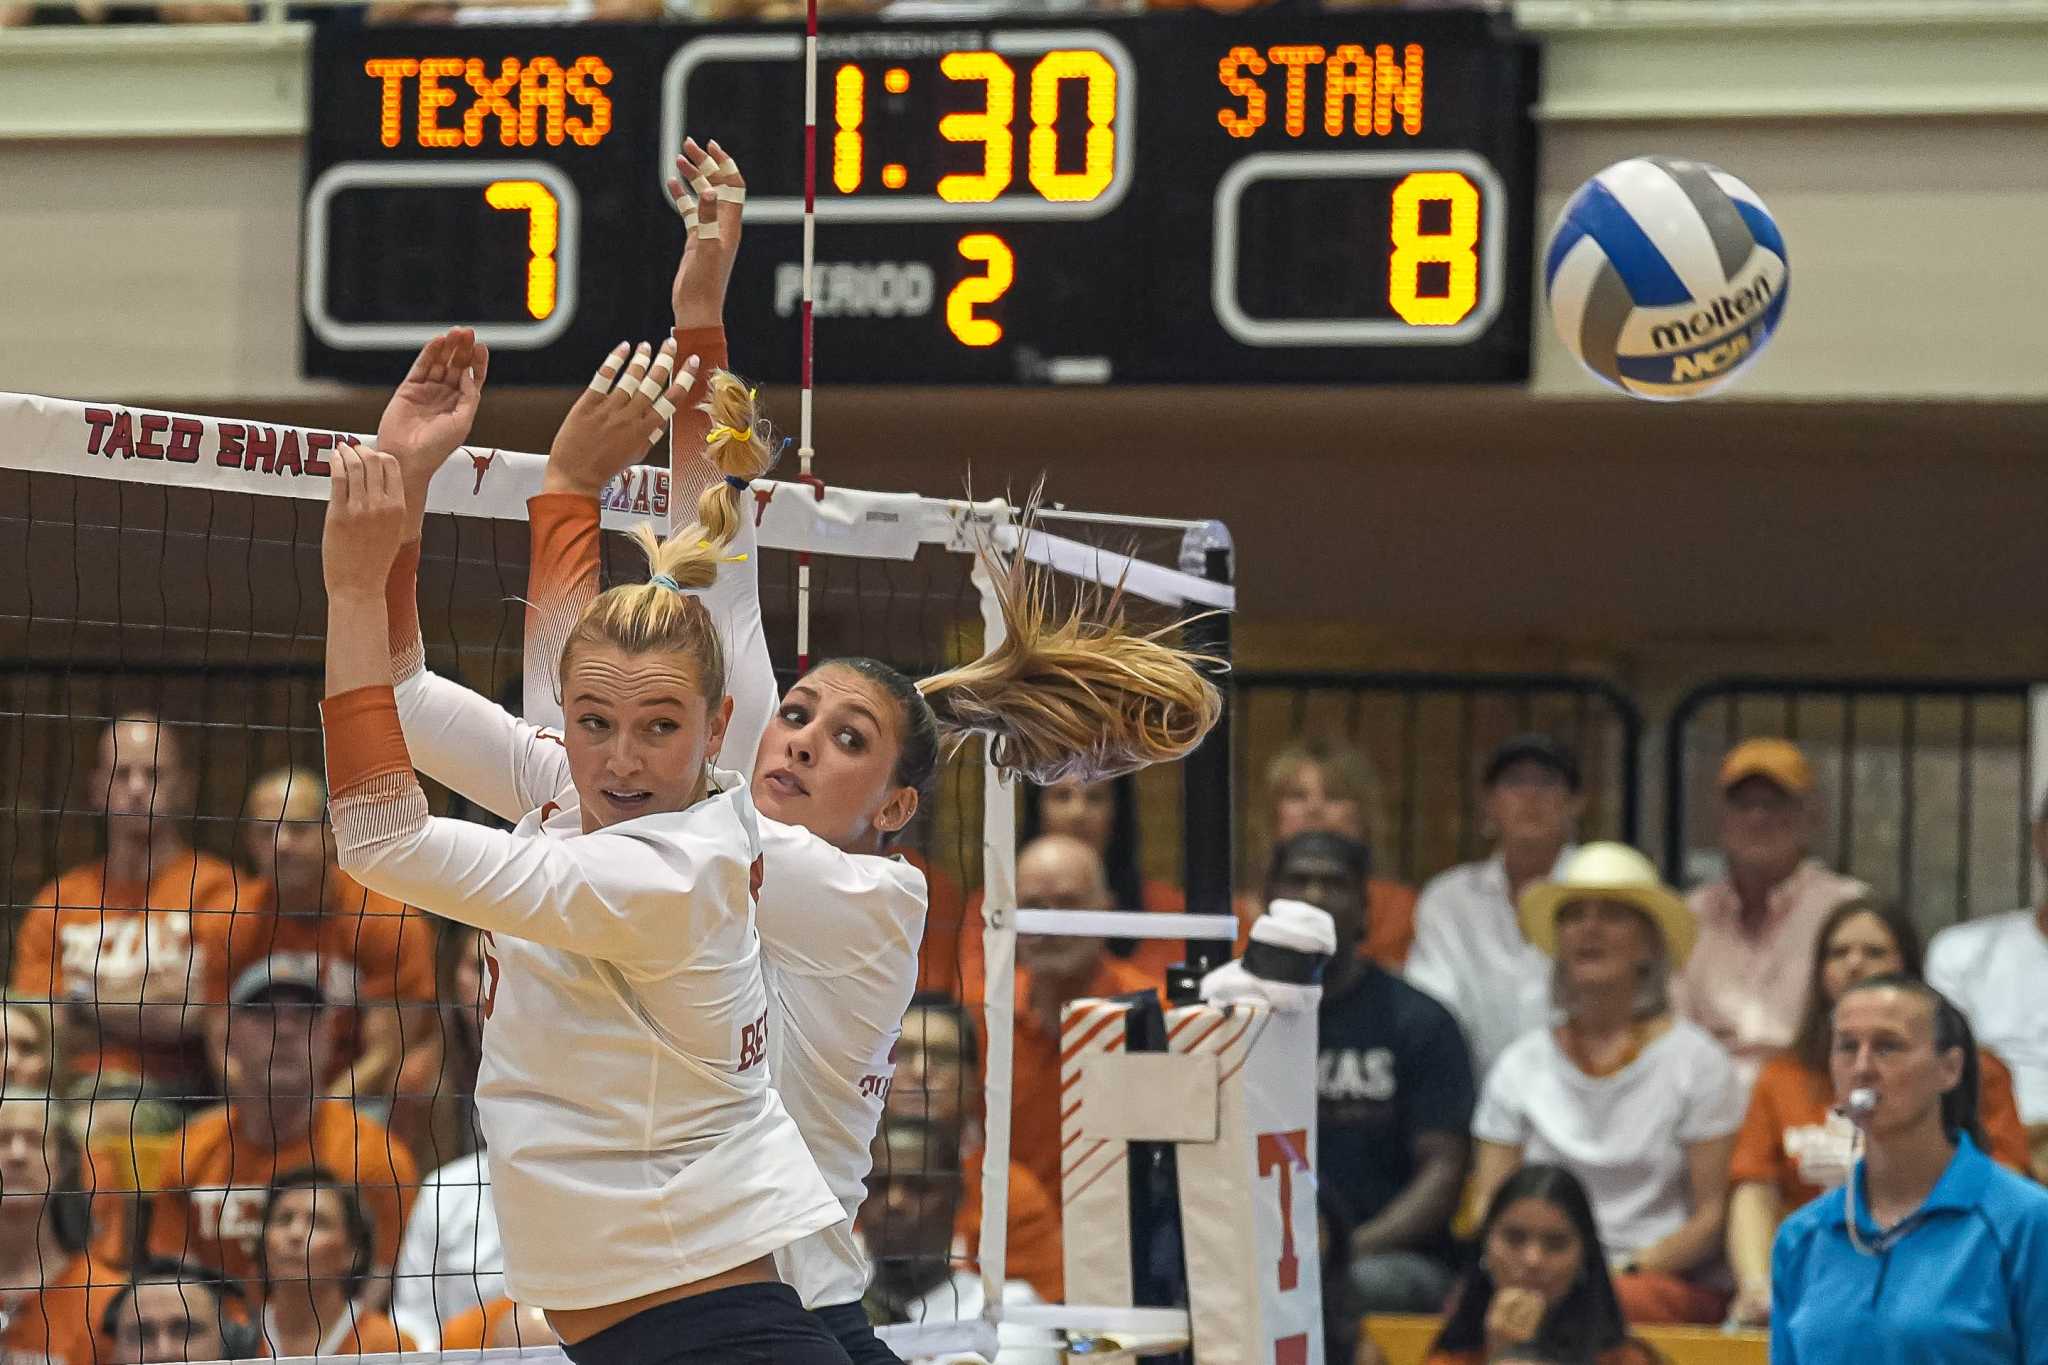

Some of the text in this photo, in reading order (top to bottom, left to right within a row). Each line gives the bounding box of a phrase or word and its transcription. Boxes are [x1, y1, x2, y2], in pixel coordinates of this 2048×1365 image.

[364, 57, 612, 147] TEXAS
[833, 50, 1117, 203] 1:30
[1218, 44, 1424, 138] STAN
[484, 179, 558, 320] 7
[946, 233, 1014, 346] 2
[1388, 170, 1480, 326] 8
[1650, 273, 1772, 350] molten
[84, 407, 362, 477] TACO SHAC
[736, 1007, 768, 1072] BE
